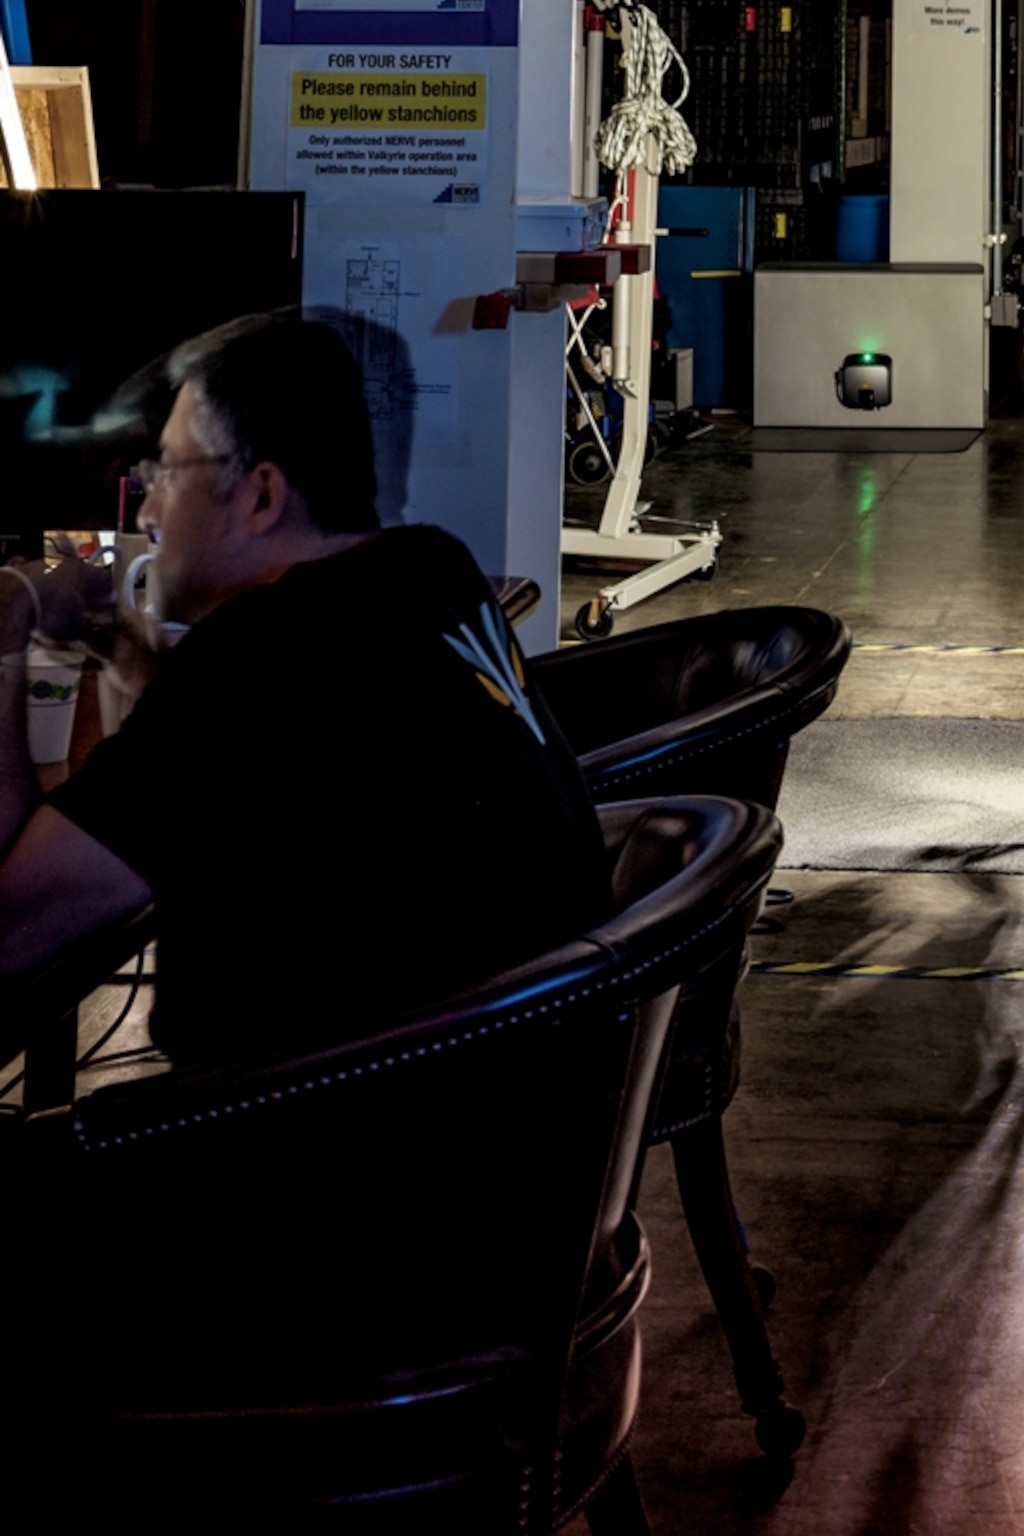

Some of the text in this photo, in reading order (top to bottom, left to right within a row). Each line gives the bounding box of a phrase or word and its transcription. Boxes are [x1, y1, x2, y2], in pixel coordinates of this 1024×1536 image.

[328, 53, 452, 69] FOR YOUR SAFETY
[301, 79, 477, 97] Please remain behind
[299, 104, 477, 124] the yellow stanchions
[308, 134, 465, 147] Only authorized NERVE personnel
[296, 150, 477, 163] allowed within Valkyrie operation area
[315, 164, 457, 177] (within the yellow stanchions)
[454, 186, 480, 196] NERVE
